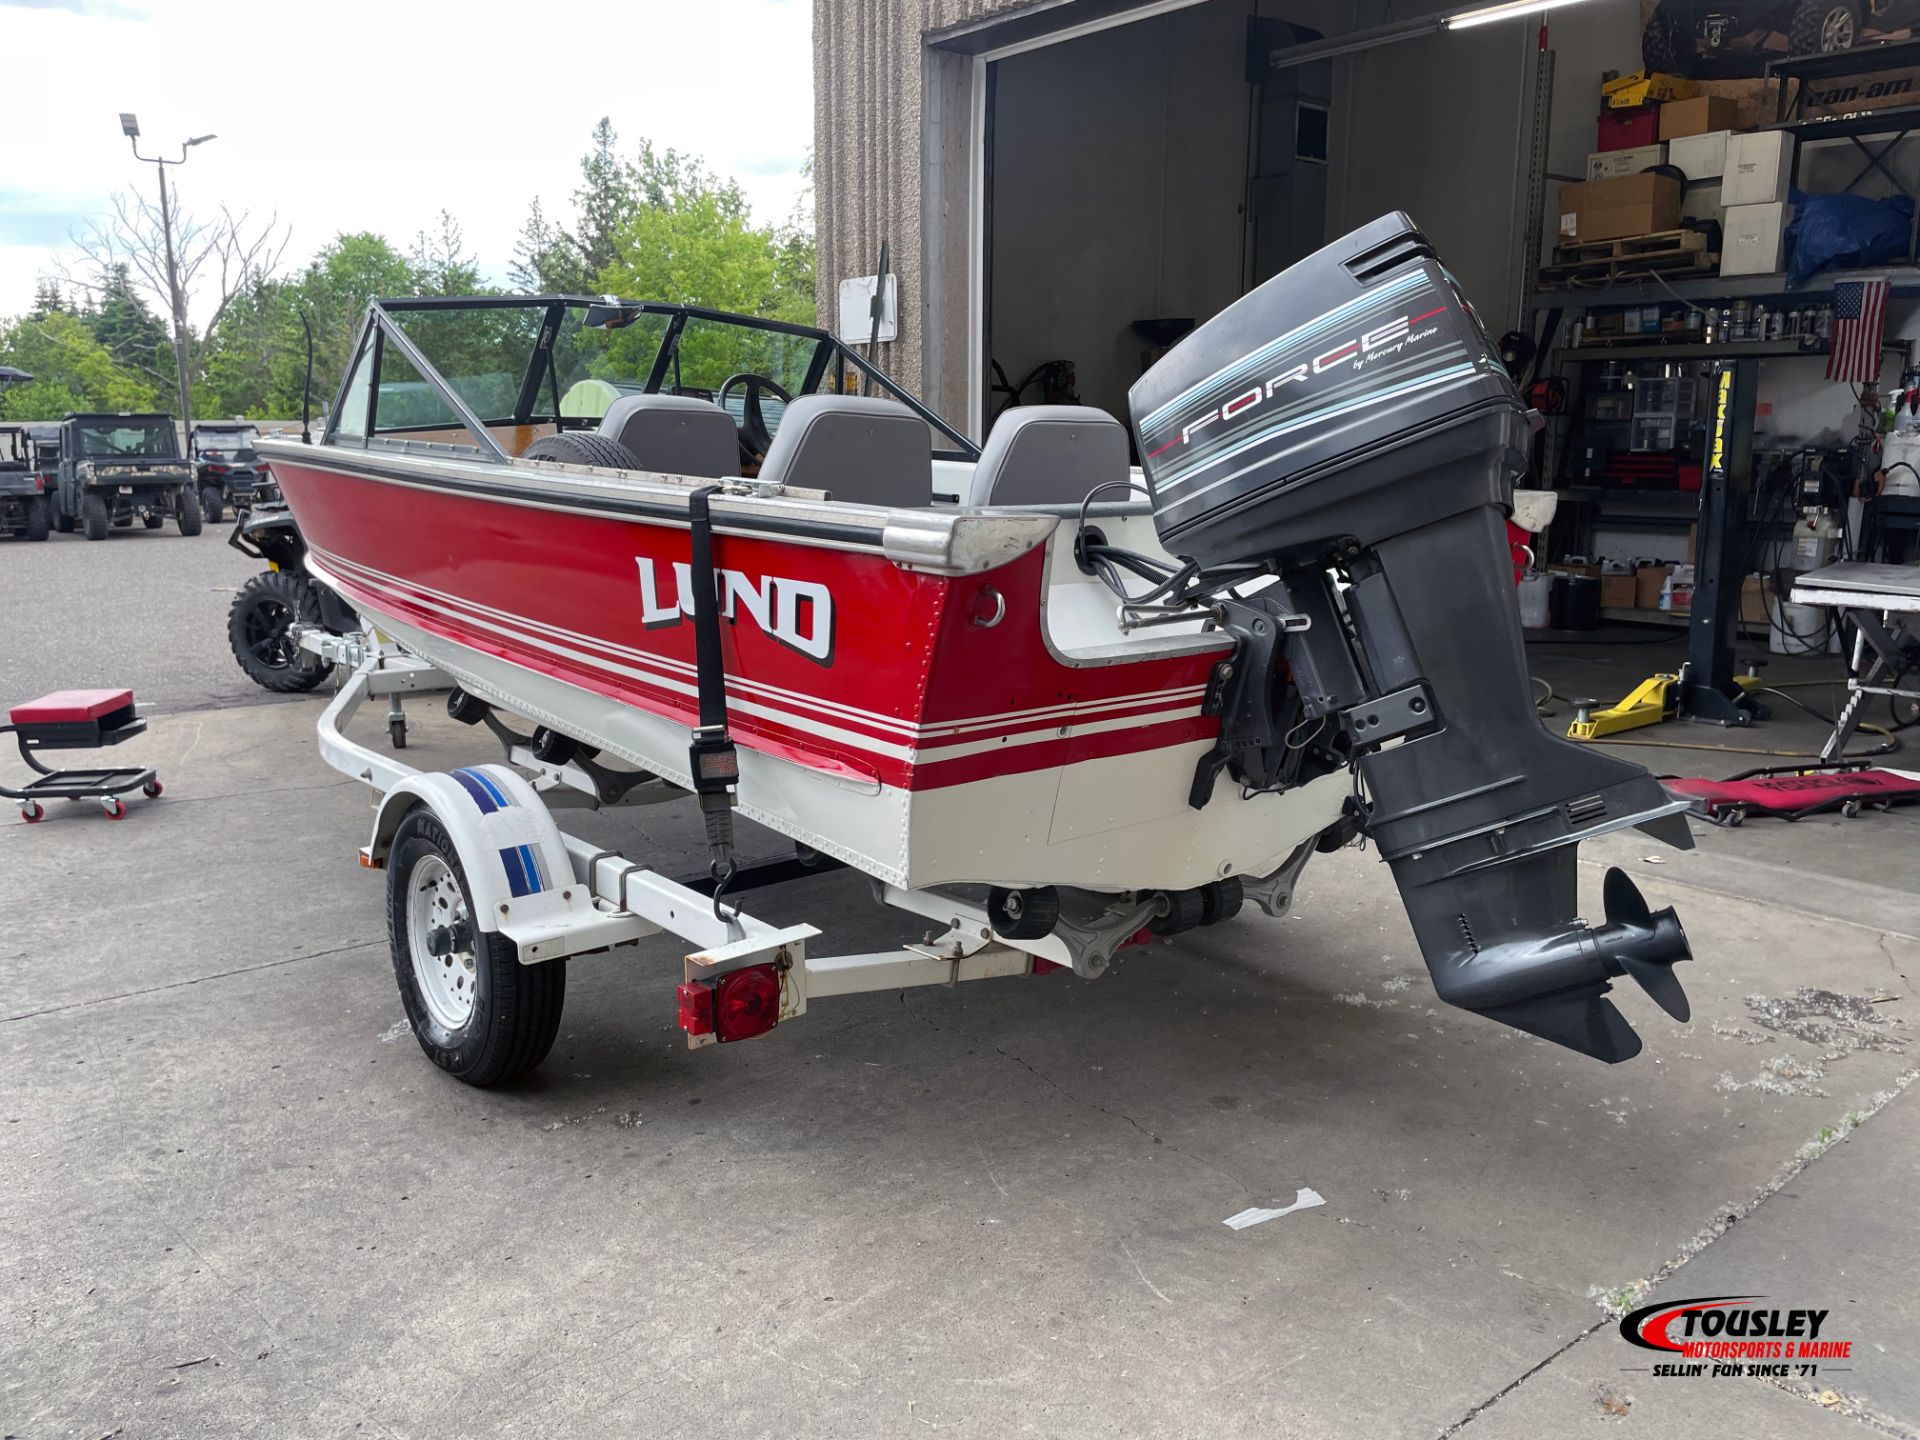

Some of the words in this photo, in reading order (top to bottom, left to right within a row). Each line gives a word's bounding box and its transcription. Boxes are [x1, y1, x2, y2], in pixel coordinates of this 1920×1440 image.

[1182, 315, 1409, 445] FORCE
[1353, 359, 1363, 370] by
[1366, 342, 1403, 363] Mercury
[1405, 326, 1438, 347] Marine
[635, 556, 835, 667] LUND
